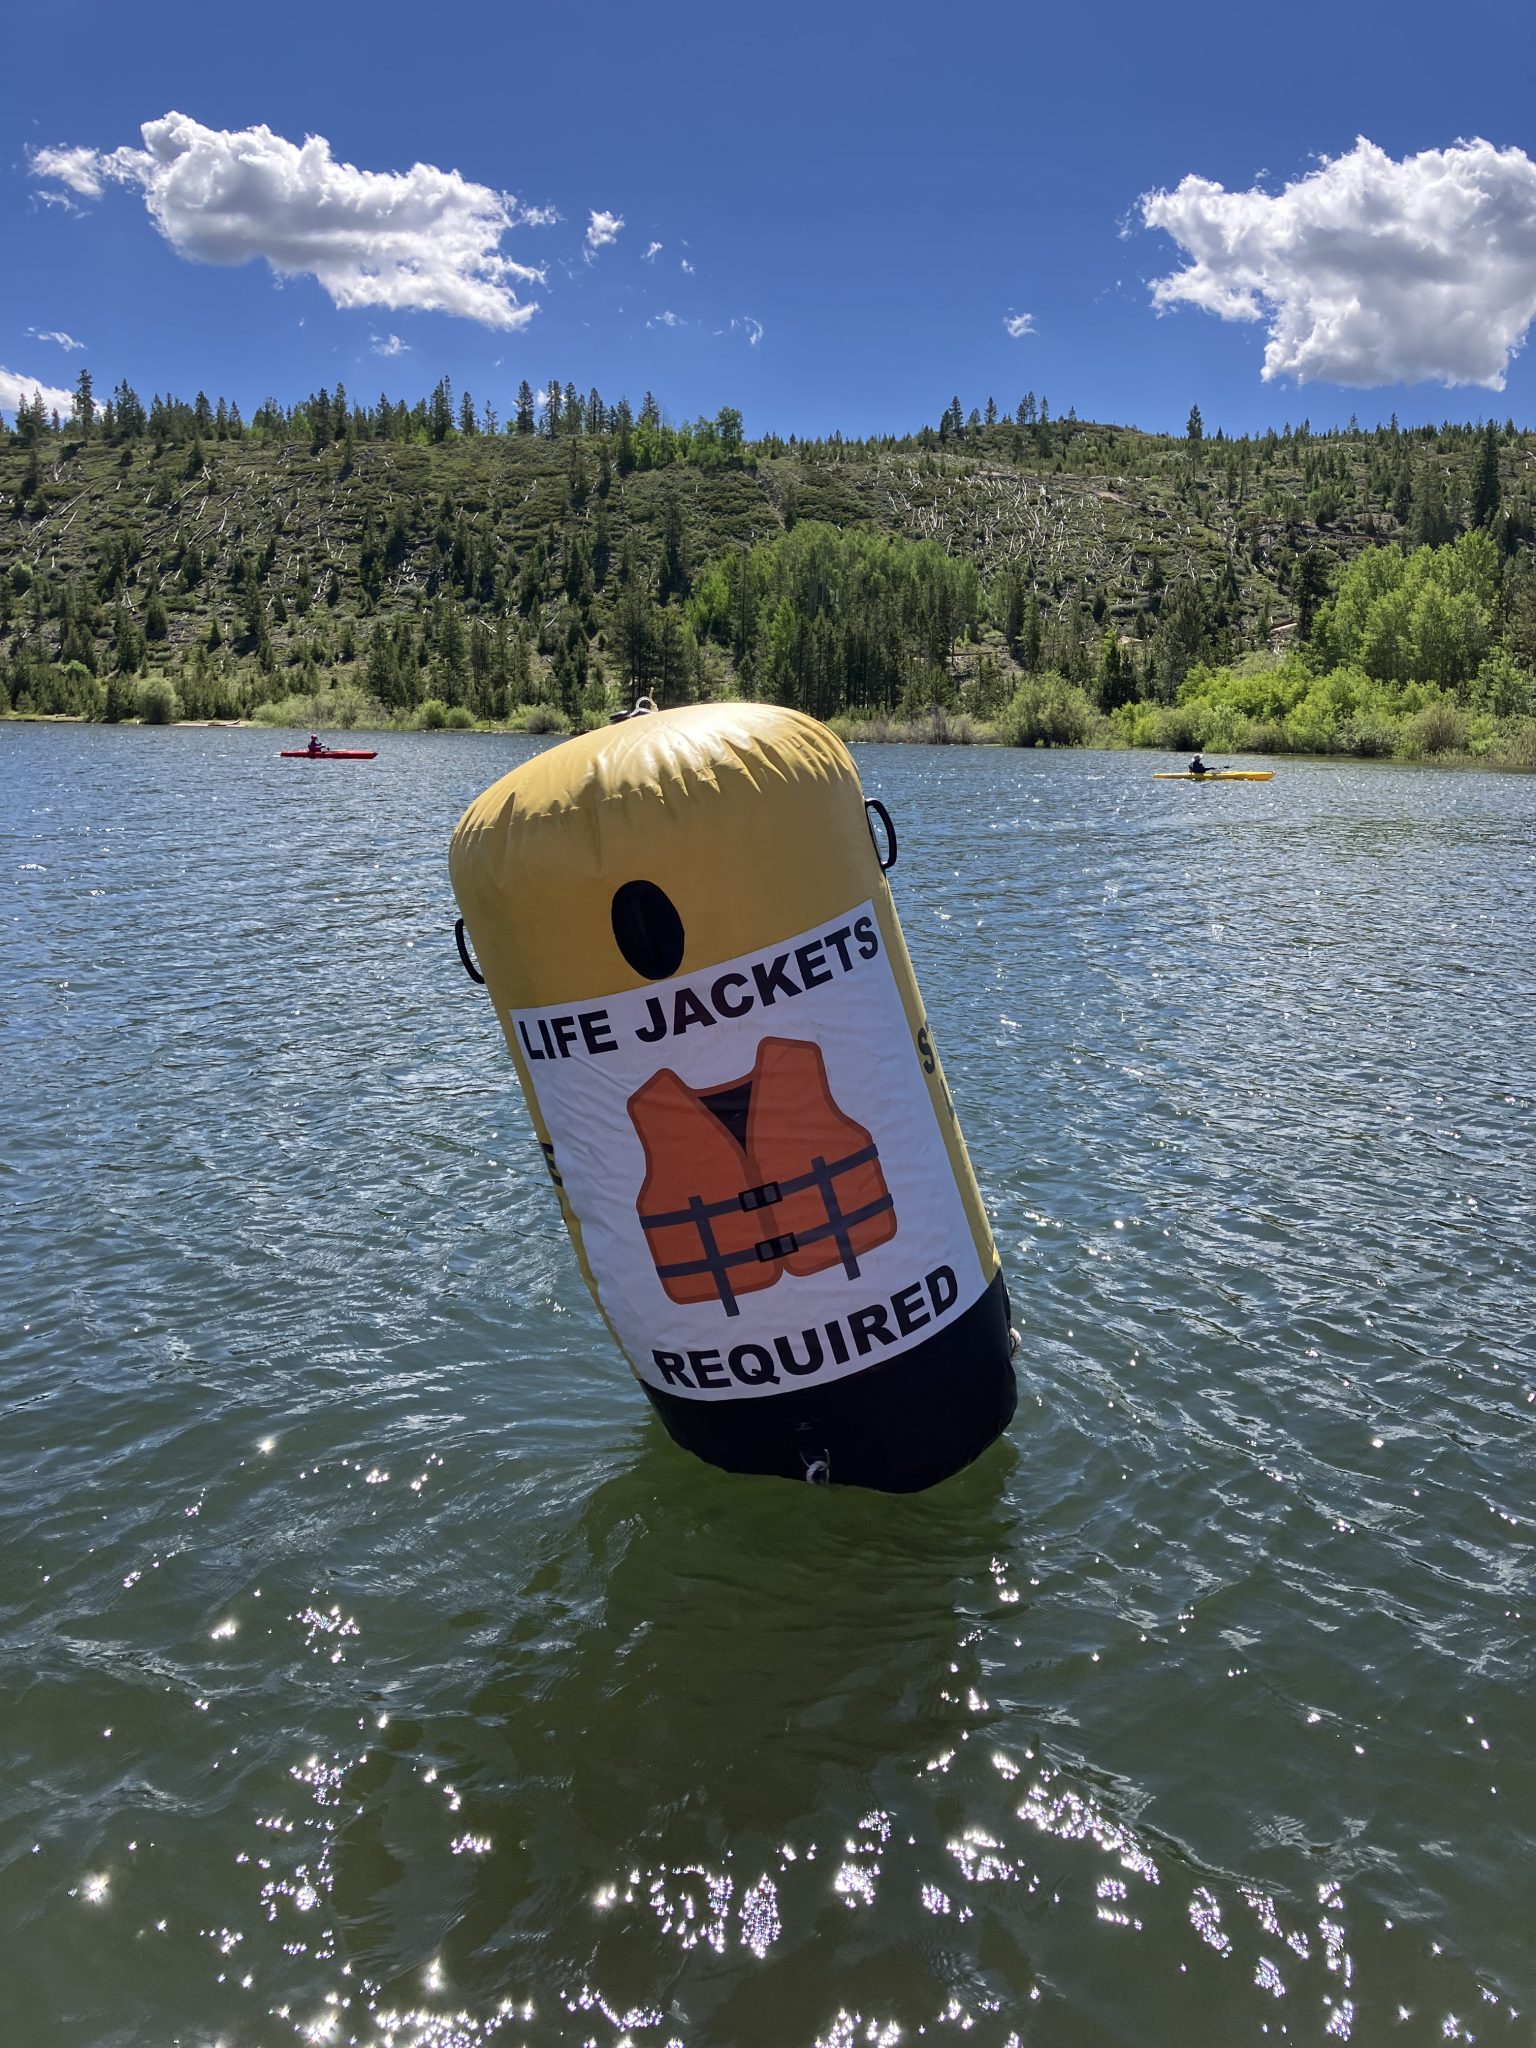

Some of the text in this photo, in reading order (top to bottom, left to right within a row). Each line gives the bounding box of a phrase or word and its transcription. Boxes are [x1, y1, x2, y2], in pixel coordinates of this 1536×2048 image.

[518, 916, 879, 1060] LIFE JACKETS
[651, 1265, 959, 1389] REQUIRED
